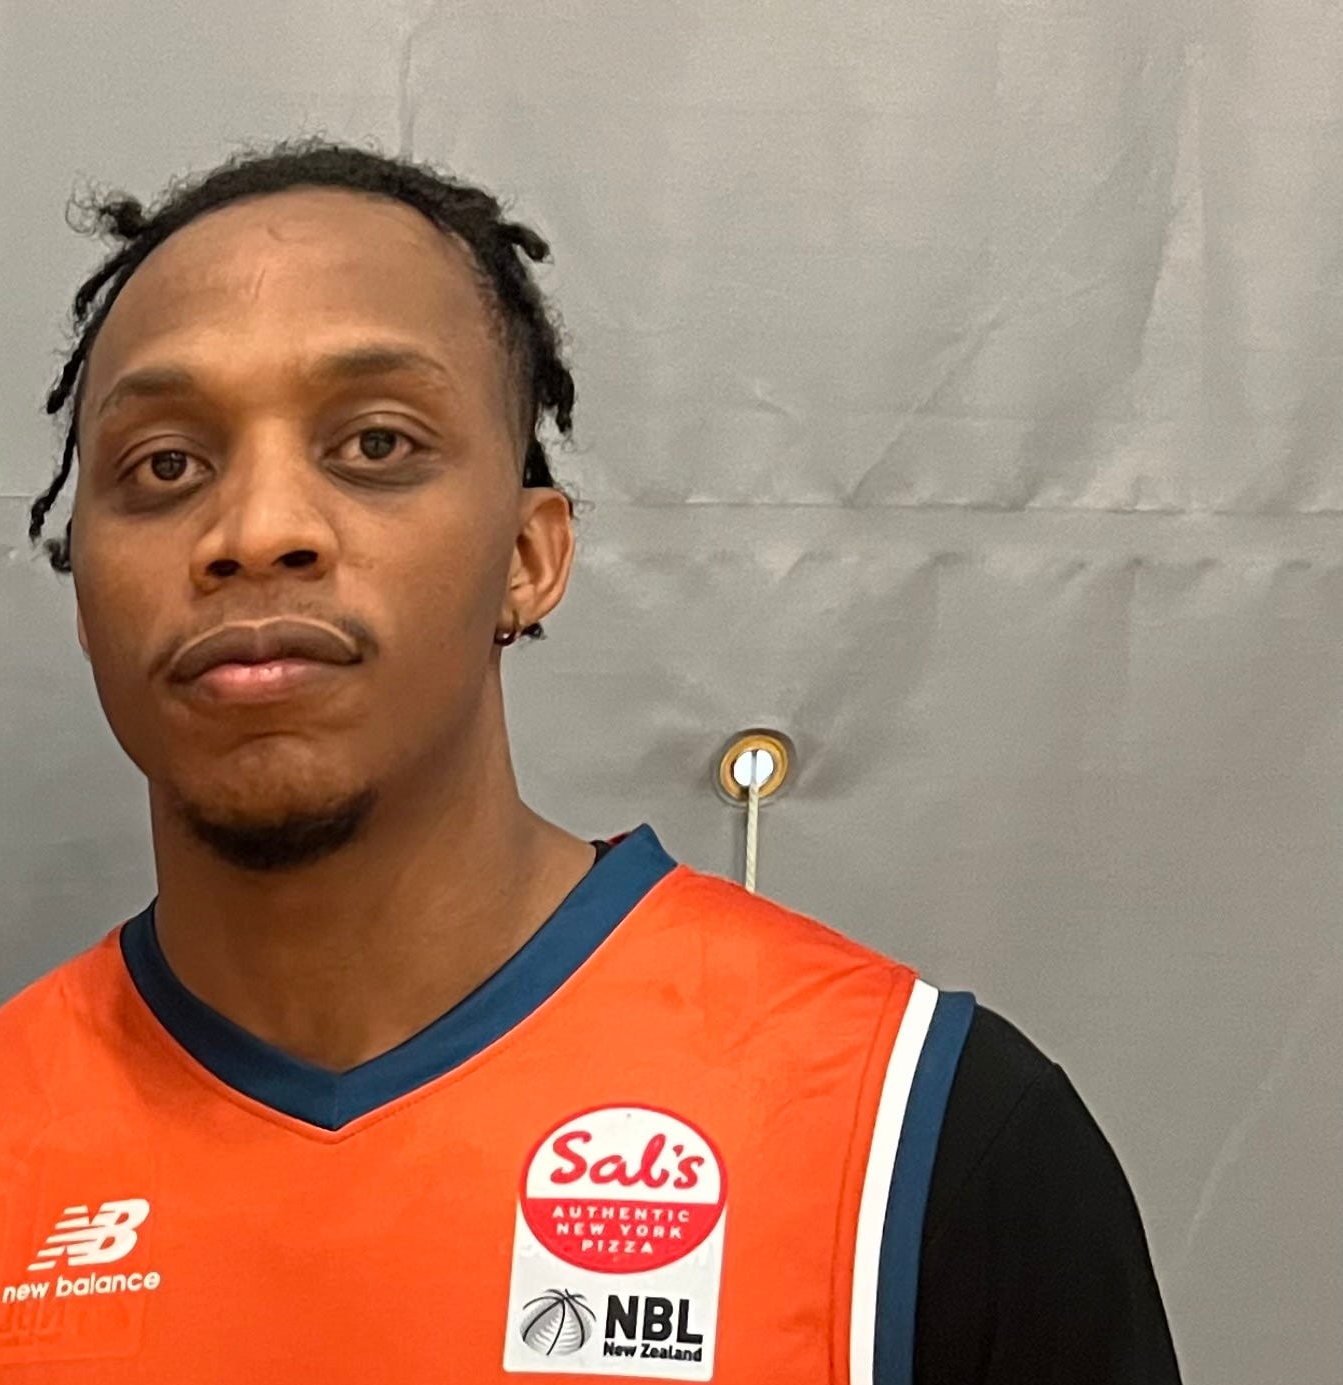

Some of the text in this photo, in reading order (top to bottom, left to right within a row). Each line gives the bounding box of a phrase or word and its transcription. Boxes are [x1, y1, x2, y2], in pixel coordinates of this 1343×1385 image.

[550, 1131, 705, 1189] Sal's
[552, 1206, 689, 1223] AUTHENTIC
[556, 1223, 682, 1238] NEW YORK
[581, 1240, 653, 1254] PIZZA
[2, 1271, 161, 1304] new balance
[604, 1294, 704, 1344] NBL
[603, 1341, 702, 1362] New Zealand
